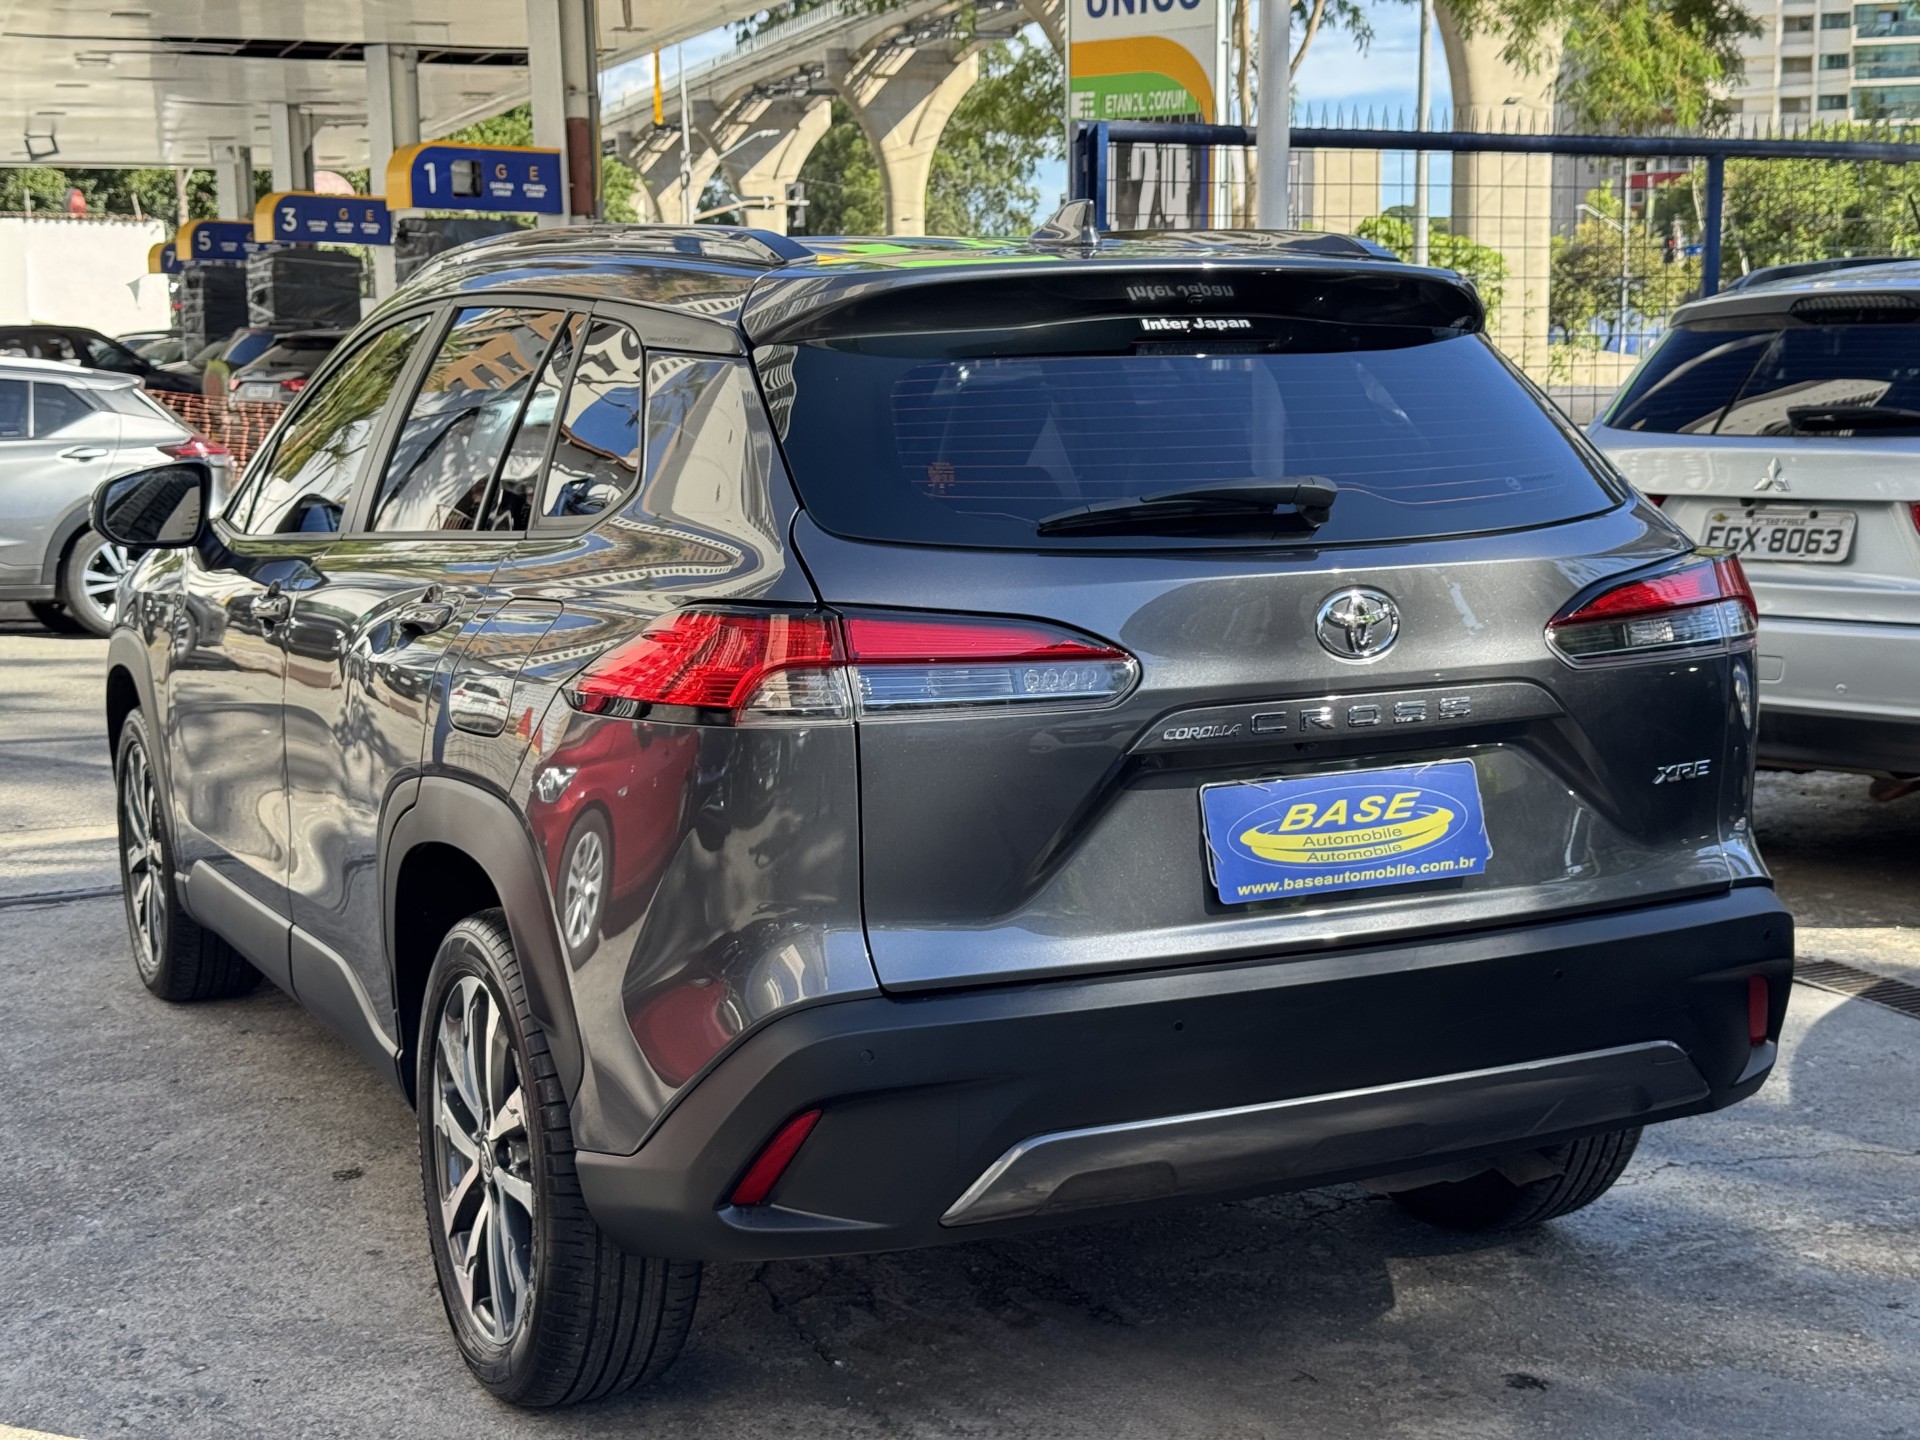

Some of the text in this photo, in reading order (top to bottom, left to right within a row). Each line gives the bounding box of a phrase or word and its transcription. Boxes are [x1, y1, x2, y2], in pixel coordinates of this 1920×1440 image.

[423, 162, 437, 194] 1
[495, 163, 540, 182] G E
[281, 207, 297, 232] 3
[197, 230, 212, 251] 5
[164, 250, 176, 268] 7
[1141, 317, 1251, 331] Inter Japan
[1162, 696, 1472, 741] COROLLA CROSS
[1651, 759, 1712, 785] XRE
[1278, 791, 1422, 832] BASE
[1302, 827, 1403, 848] Automobile
[1306, 843, 1403, 862] Automobile
[1236, 856, 1478, 896] www.baseautomobile.com.br
